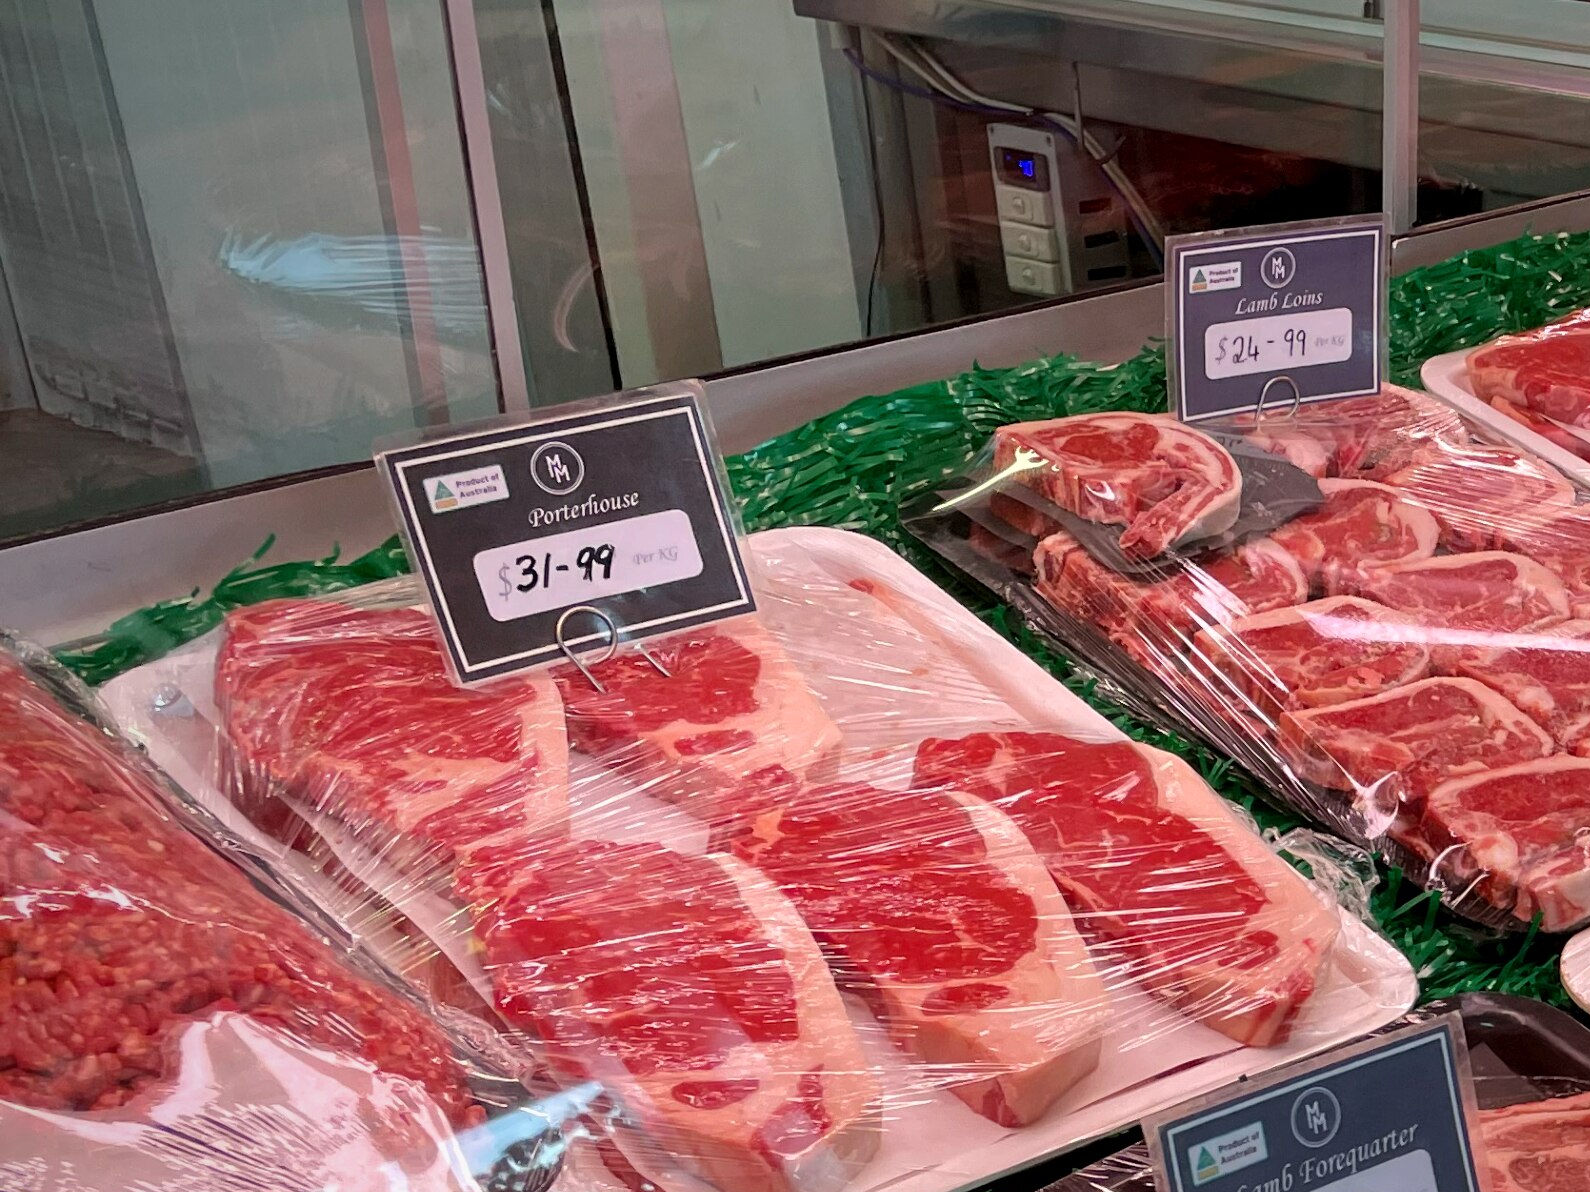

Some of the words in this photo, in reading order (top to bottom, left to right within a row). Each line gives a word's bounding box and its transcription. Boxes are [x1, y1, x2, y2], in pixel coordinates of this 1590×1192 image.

[1235, 292, 1278, 315] Lamb
[1281, 289, 1324, 309] Loins
[456, 475, 488, 489] Product
[490, 473, 499, 482] of
[459, 484, 498, 499] Australia
[528, 491, 640, 528] Porterhouse
[632, 552, 654, 565] Per
[657, 546, 679, 562] KG
[1218, 1136, 1249, 1153] Product
[1250, 1131, 1260, 1142] of
[1220, 1145, 1257, 1166] Australia
[1298, 1123, 1418, 1187] Forequarter
